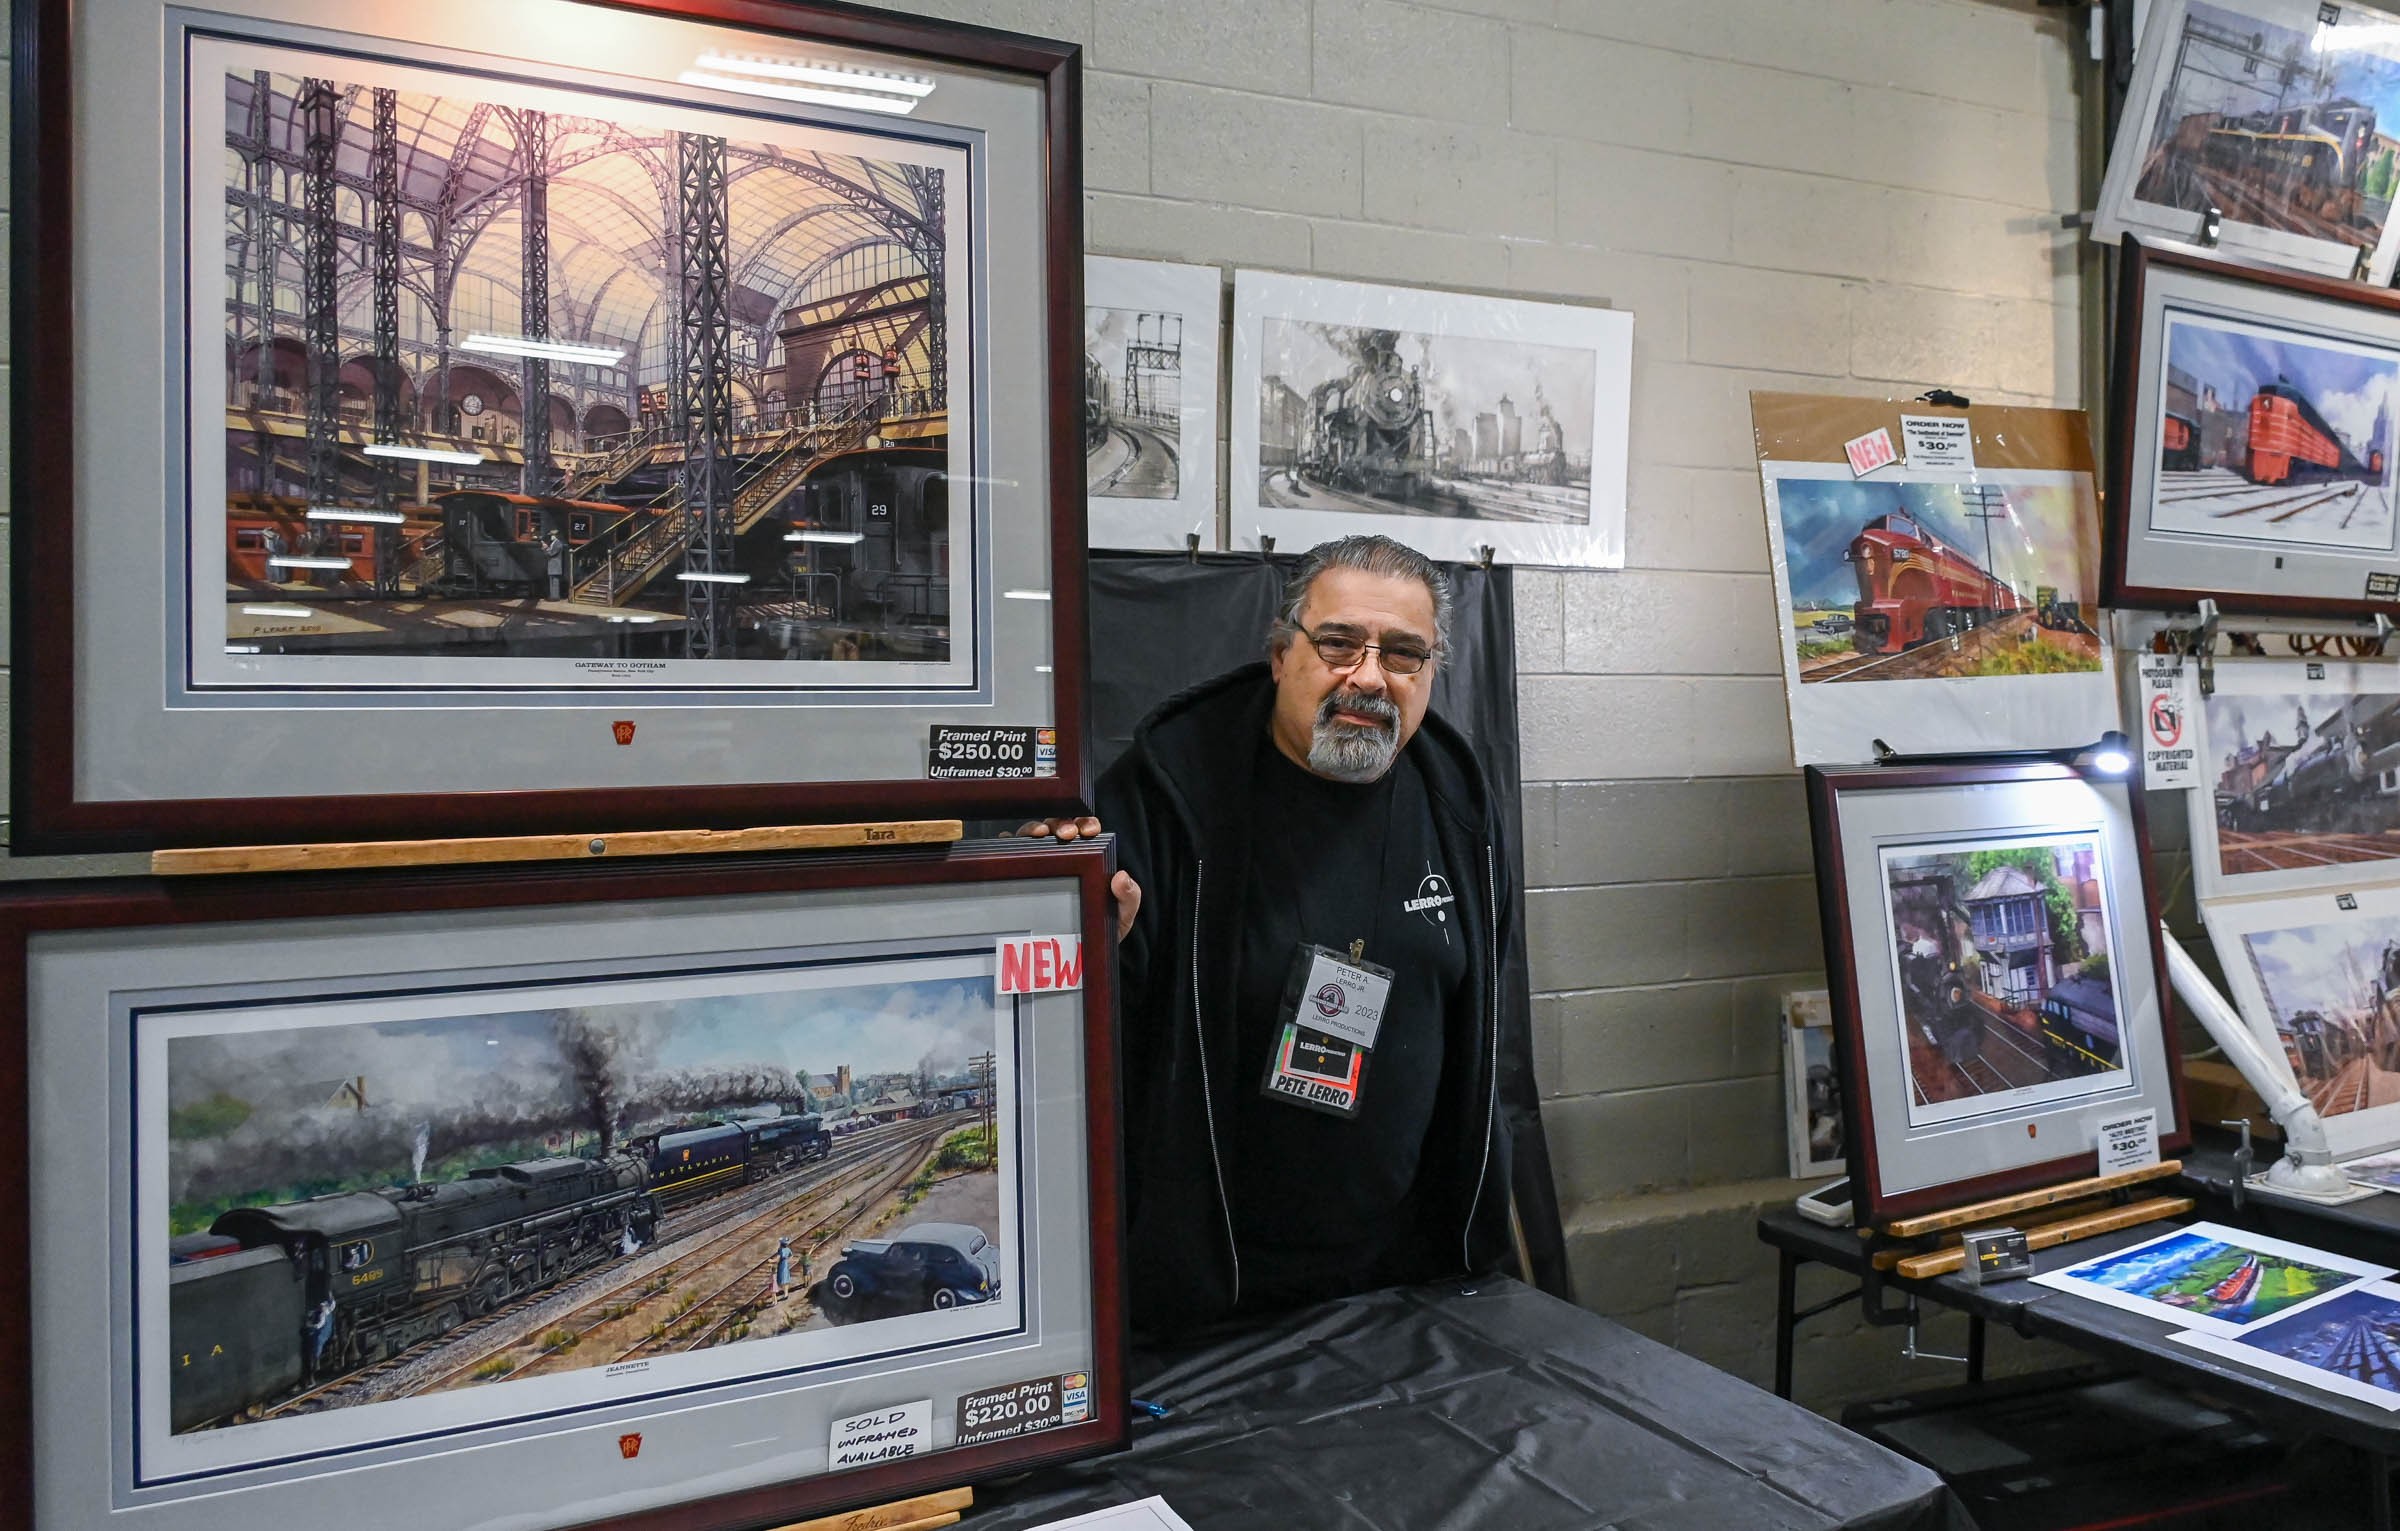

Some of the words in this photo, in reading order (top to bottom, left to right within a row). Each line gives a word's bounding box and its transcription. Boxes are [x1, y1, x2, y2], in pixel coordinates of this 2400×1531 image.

[1906, 420, 1939, 428] ORDER
[1848, 433, 1892, 473] NEW
[871, 504, 887, 516] 29
[574, 522, 586, 531] 27
[2152, 679, 2173, 689] PLEASE
[939, 729, 991, 742] Framed
[993, 730, 1027, 742] Print
[938, 742, 1024, 760] $250.00
[930, 766, 994, 777] Unframed
[996, 766, 1032, 778] $30.00
[2155, 761, 2188, 772] MATERIAL
[864, 828, 896, 841] Tara
[1403, 895, 1442, 912] LERRO
[1002, 938, 1083, 993] NEW
[1336, 966, 1362, 982] PETER
[1335, 977, 1357, 989] LERRO
[1355, 1004, 1379, 1021] 2023
[1312, 1014, 1330, 1024] LERRO
[1330, 1020, 1366, 1036] PRODUCTIONS
[1300, 1041, 1327, 1054] LERRO
[1275, 1074, 1307, 1095] PETE
[1307, 1083, 1350, 1106] LERRO
[2102, 1120, 2132, 1131] ORDER
[606, 1361, 649, 1373] JEANNETTE
[965, 1387, 1017, 1410] Framed
[1019, 1382, 1053, 1398] Print
[1066, 1390, 1086, 1401] VISA
[965, 1395, 1050, 1427] $220.00
[845, 1411, 906, 1432] SOLD
[837, 1427, 918, 1449] UNFRAMED
[957, 1423, 1021, 1446] Unframed
[1023, 1414, 1060, 1432] $30.00
[837, 1443, 915, 1465] AVAILABLE
